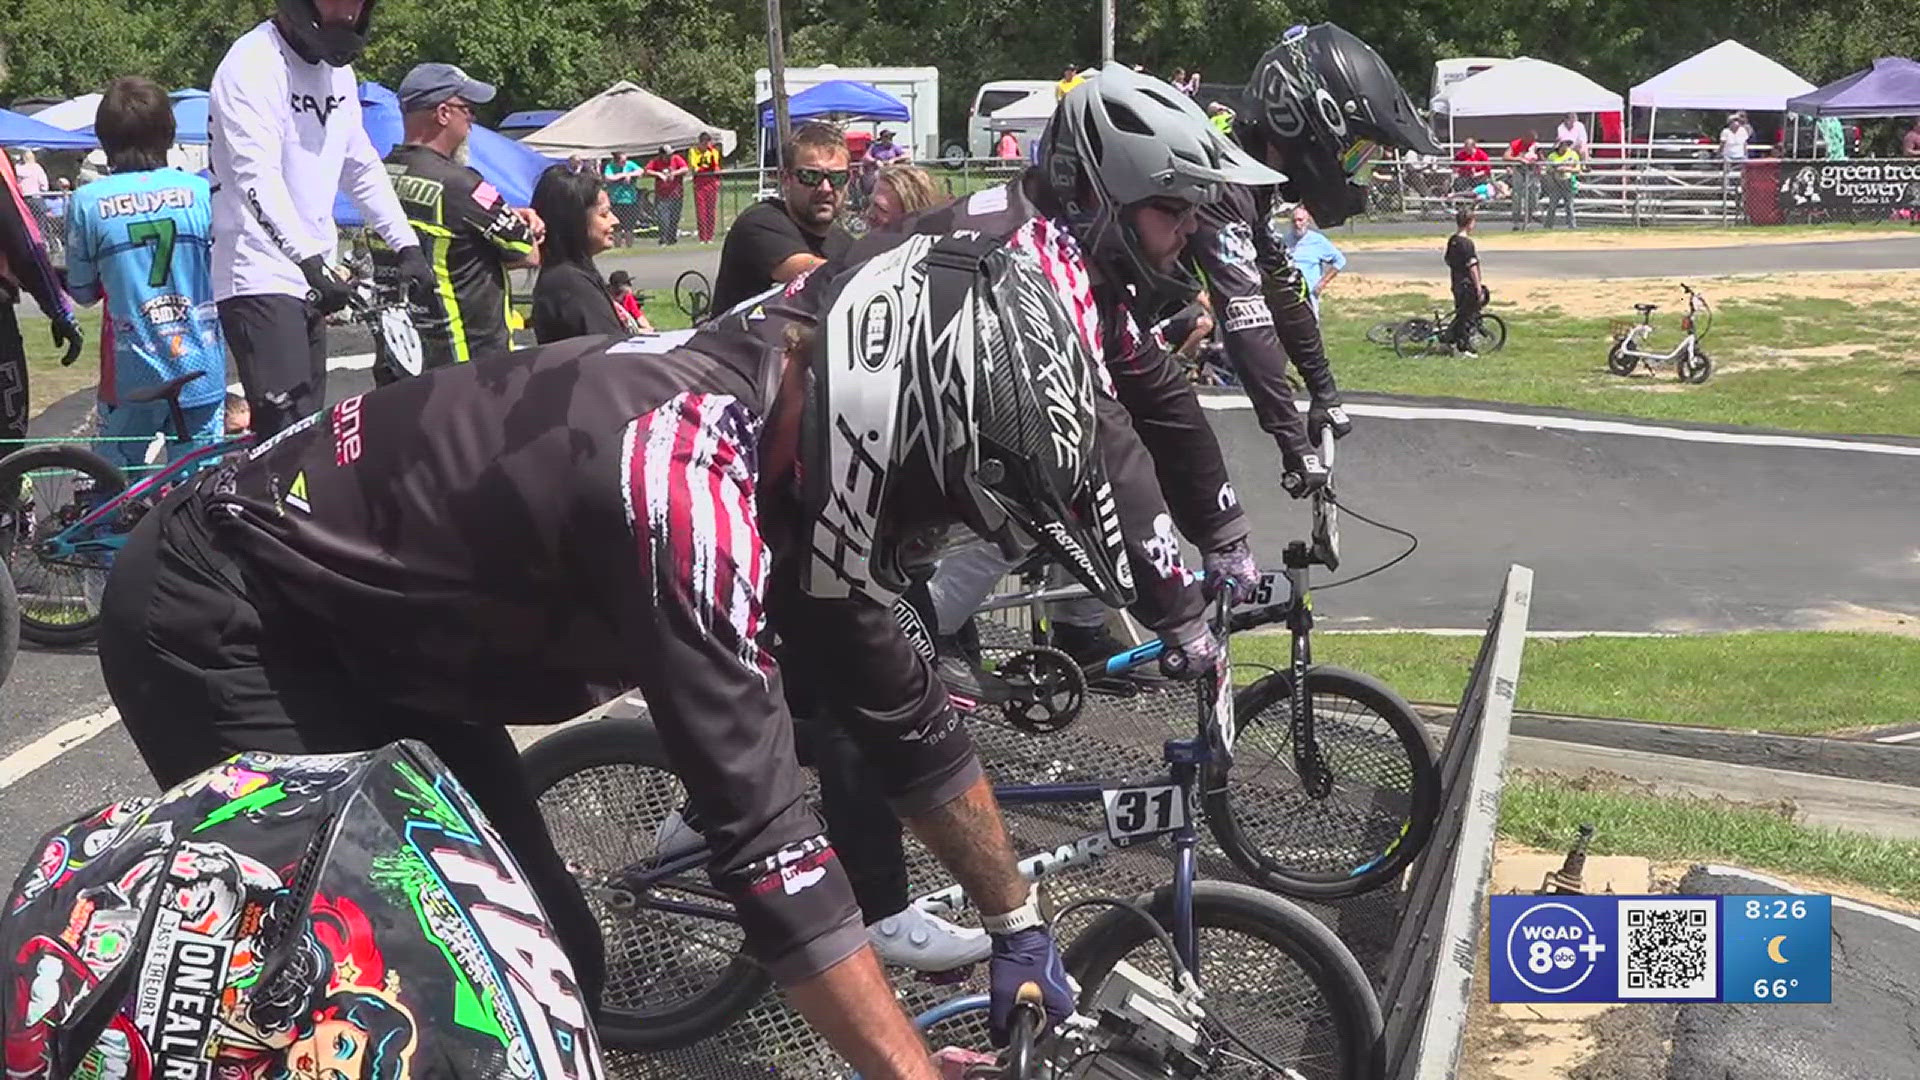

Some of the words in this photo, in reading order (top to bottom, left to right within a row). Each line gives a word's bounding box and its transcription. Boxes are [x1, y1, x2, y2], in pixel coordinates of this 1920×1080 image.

[1820, 165, 1880, 189] green
[1836, 182, 1909, 202] brewery
[98, 189, 194, 219] NGUYEN
[127, 218, 178, 288] 7
[150, 305, 188, 325] BMX
[866, 301, 888, 361] BELL
[341, 394, 362, 464] one
[1115, 790, 1173, 833] 31
